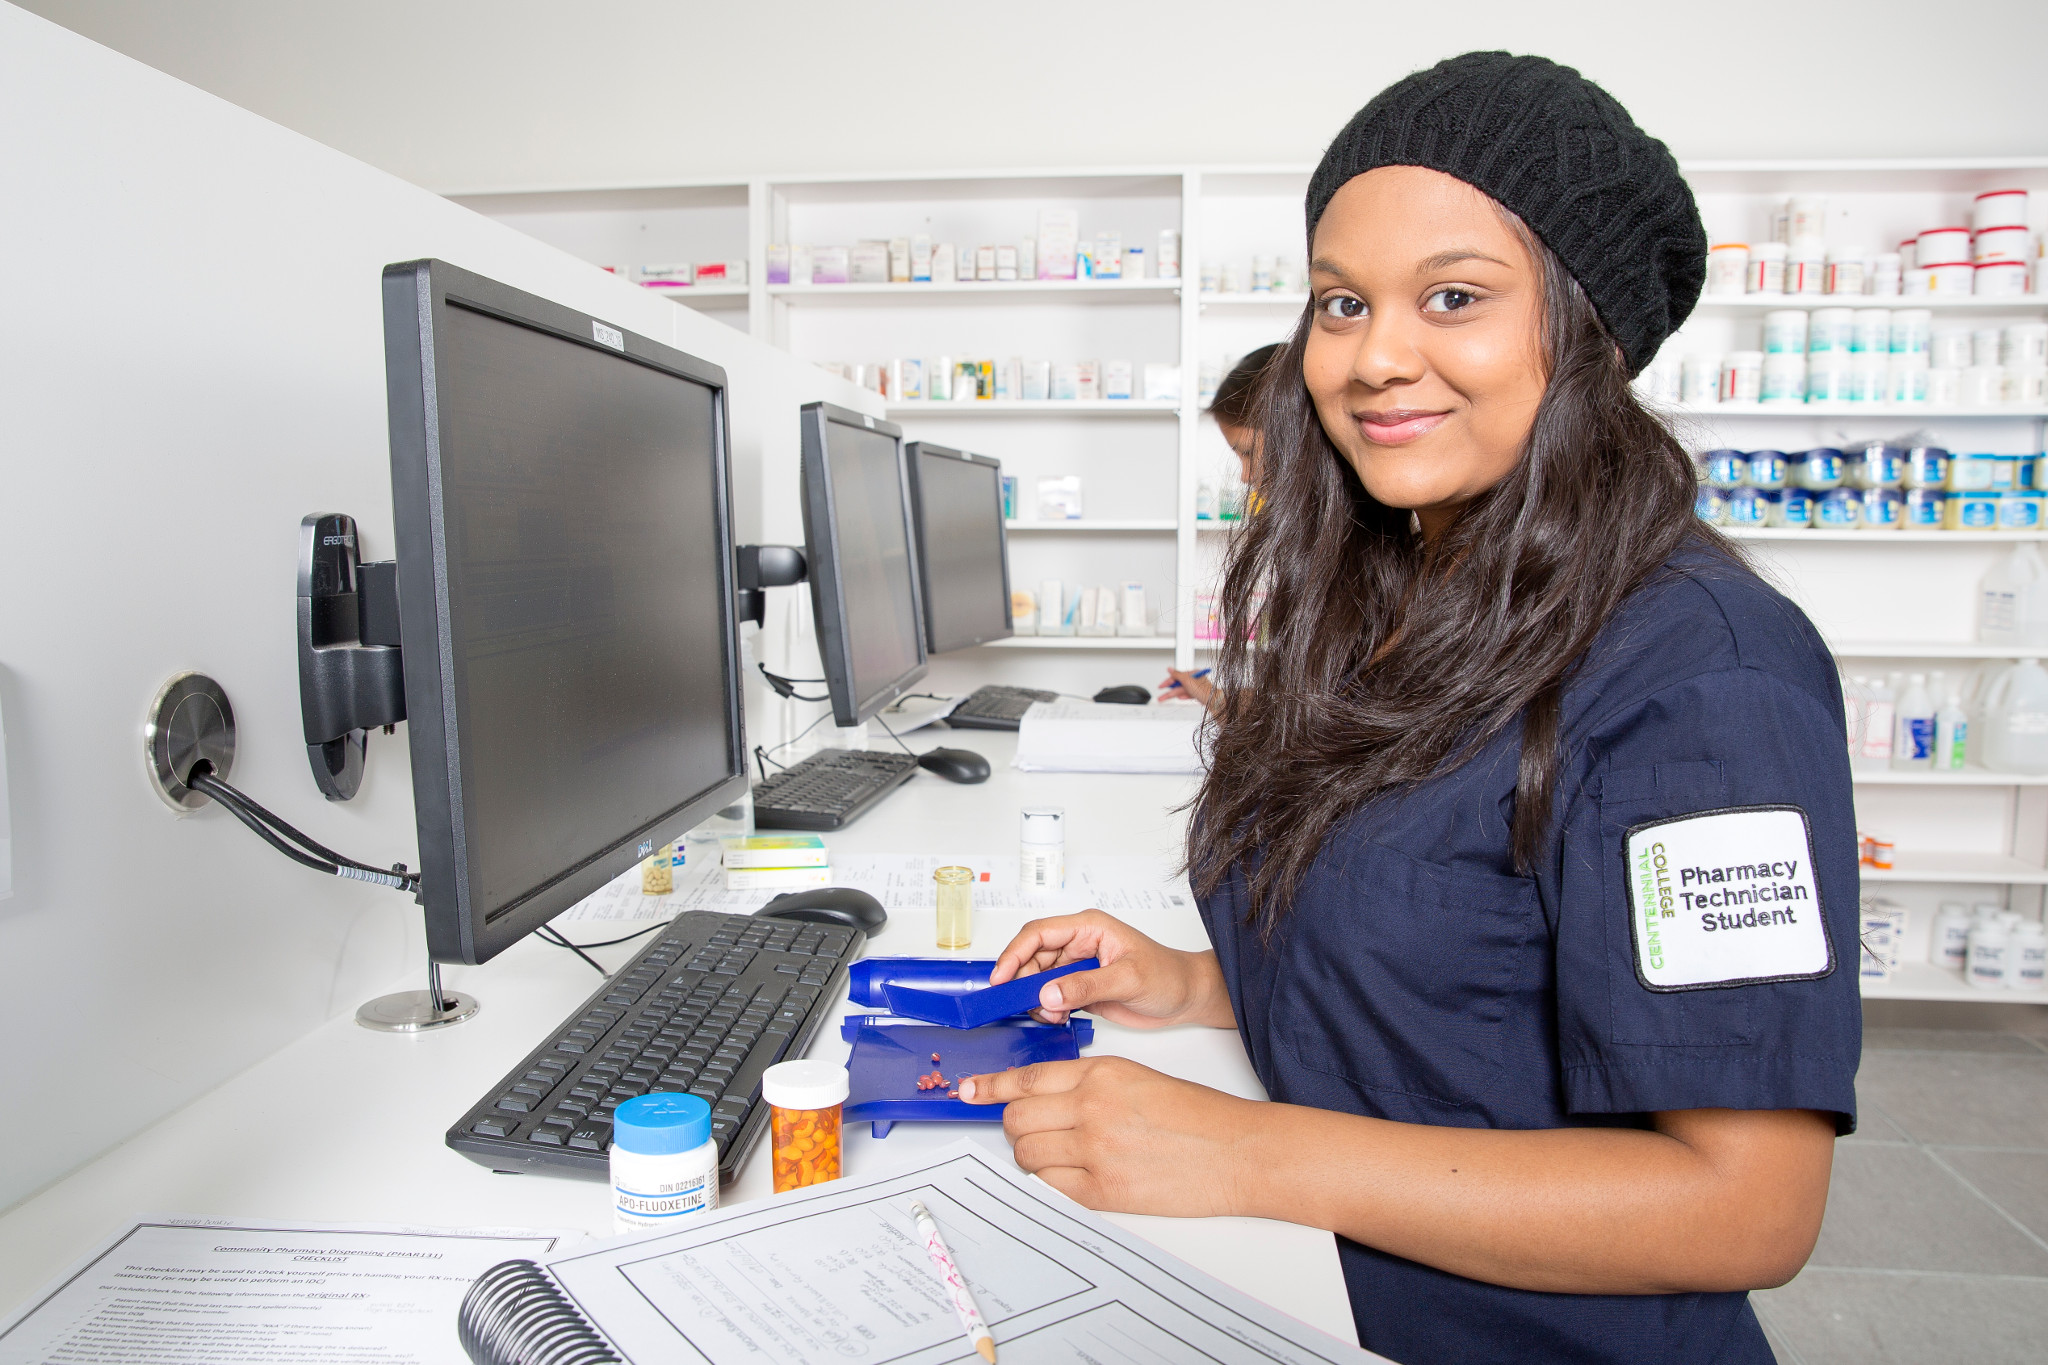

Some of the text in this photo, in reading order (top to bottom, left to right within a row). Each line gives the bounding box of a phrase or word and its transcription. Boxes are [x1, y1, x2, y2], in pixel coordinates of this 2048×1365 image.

[1652, 842, 1675, 919] COLLEGE
[1680, 860, 1797, 887] Pharmacy
[1638, 848, 1664, 969] CENTENNIAL
[1680, 882, 1808, 910] Technician
[1701, 906, 1797, 931] Student
[659, 1183, 673, 1193] DIN
[619, 1193, 702, 1211] APO-FLUOXETINE
